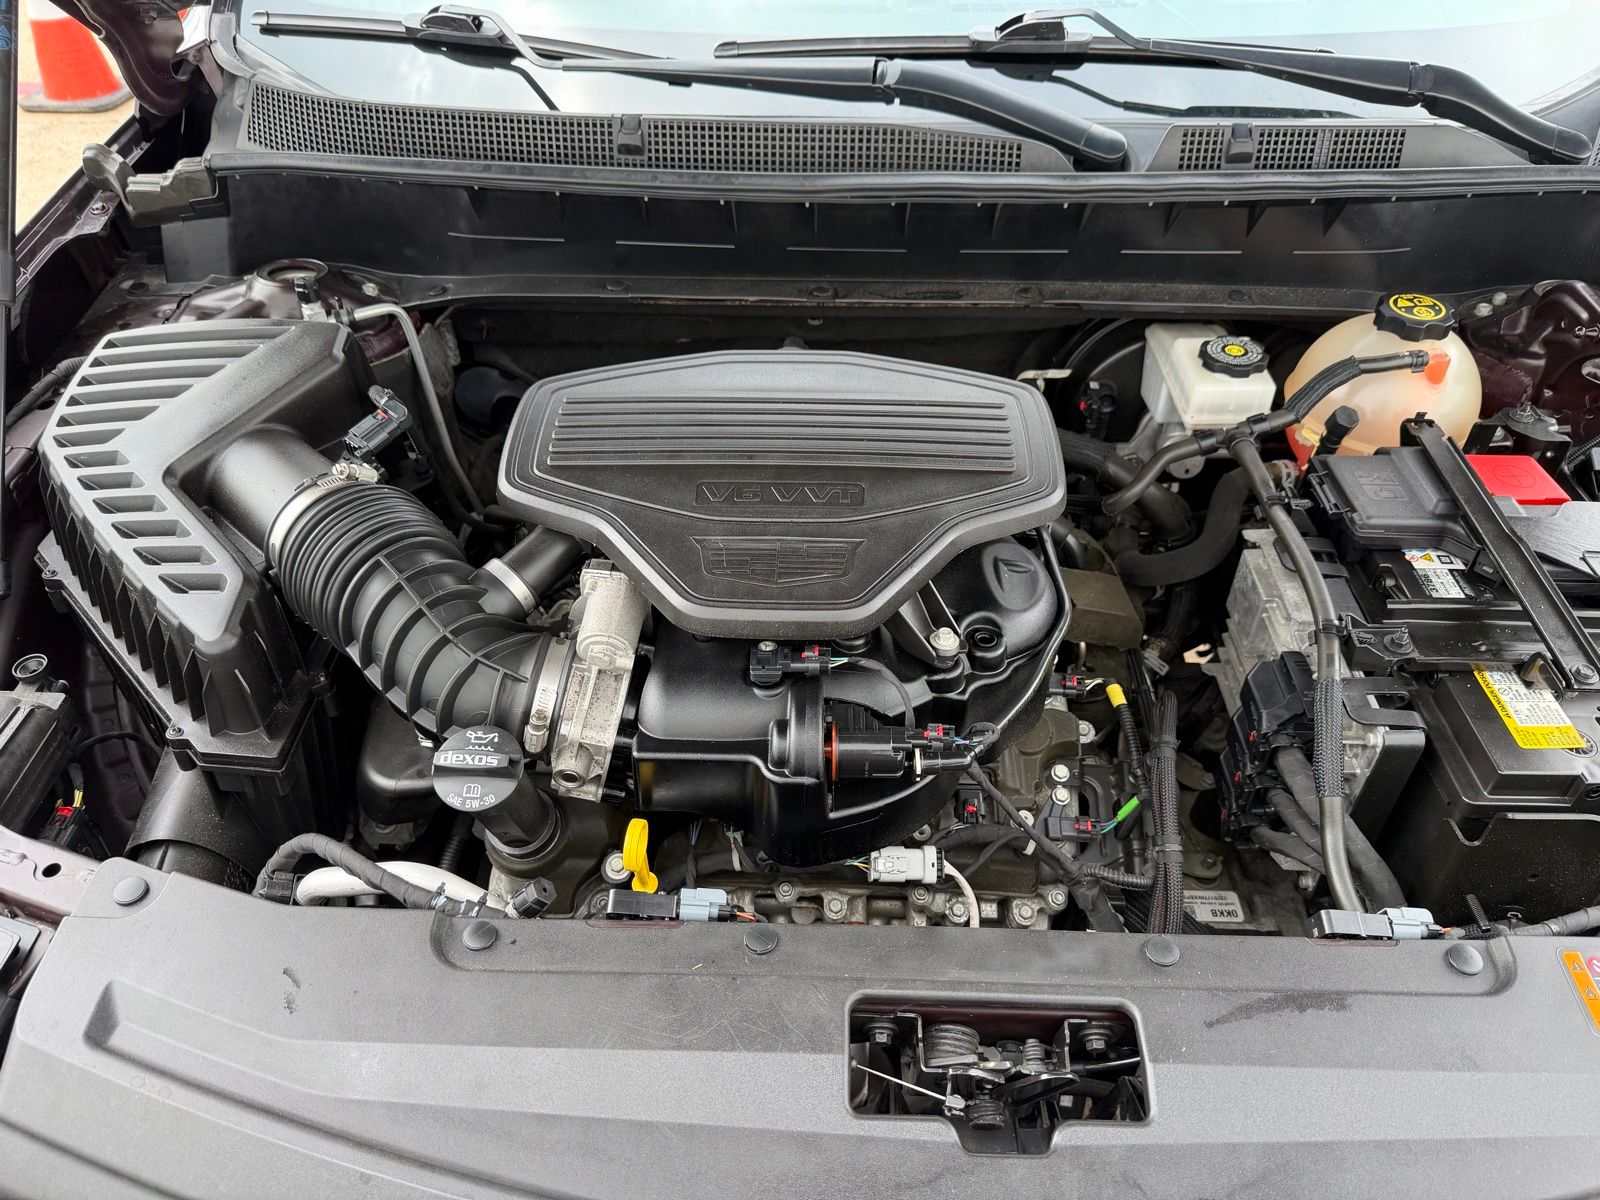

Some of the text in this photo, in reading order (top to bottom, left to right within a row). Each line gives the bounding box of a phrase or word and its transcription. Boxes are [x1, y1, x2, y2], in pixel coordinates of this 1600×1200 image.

[702, 485, 859, 503] V6 VVT
[439, 751, 501, 766] dexos
[447, 793, 496, 809] SAE 5W-30
